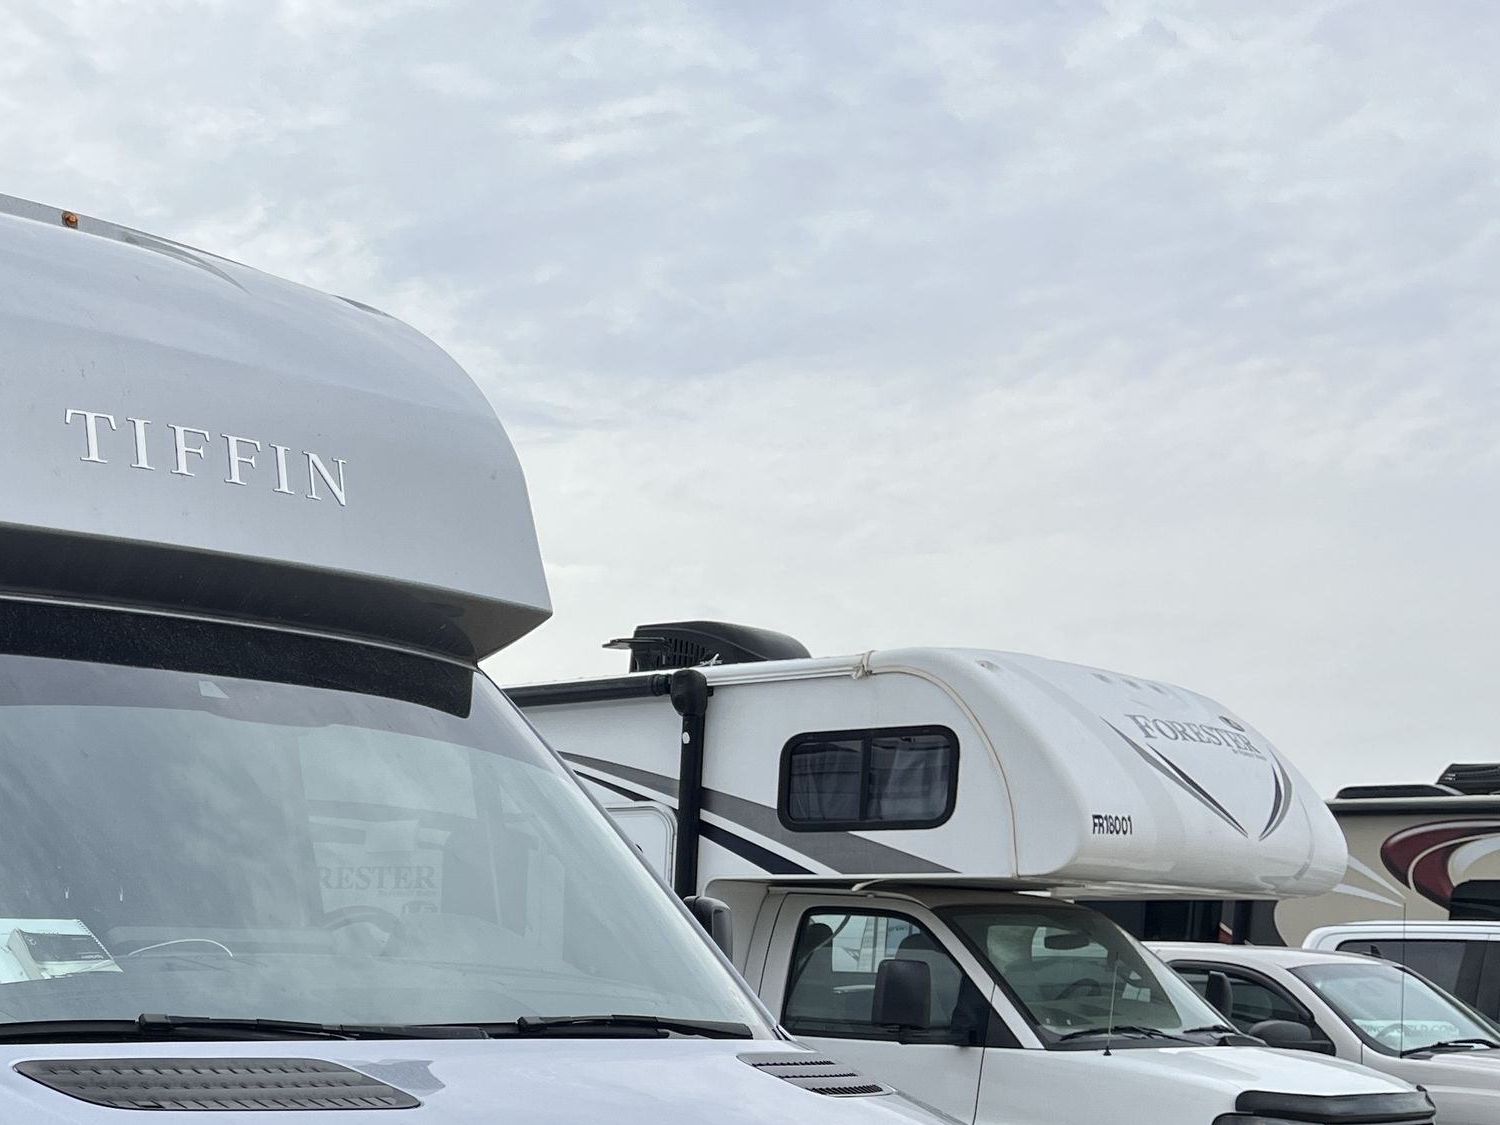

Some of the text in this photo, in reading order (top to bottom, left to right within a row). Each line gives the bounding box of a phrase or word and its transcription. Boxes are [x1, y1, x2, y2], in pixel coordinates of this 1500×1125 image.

[64, 407, 348, 507] TIFFIN
[1124, 713, 1262, 754] FORESTER
[1092, 814, 1134, 836] FR18001
